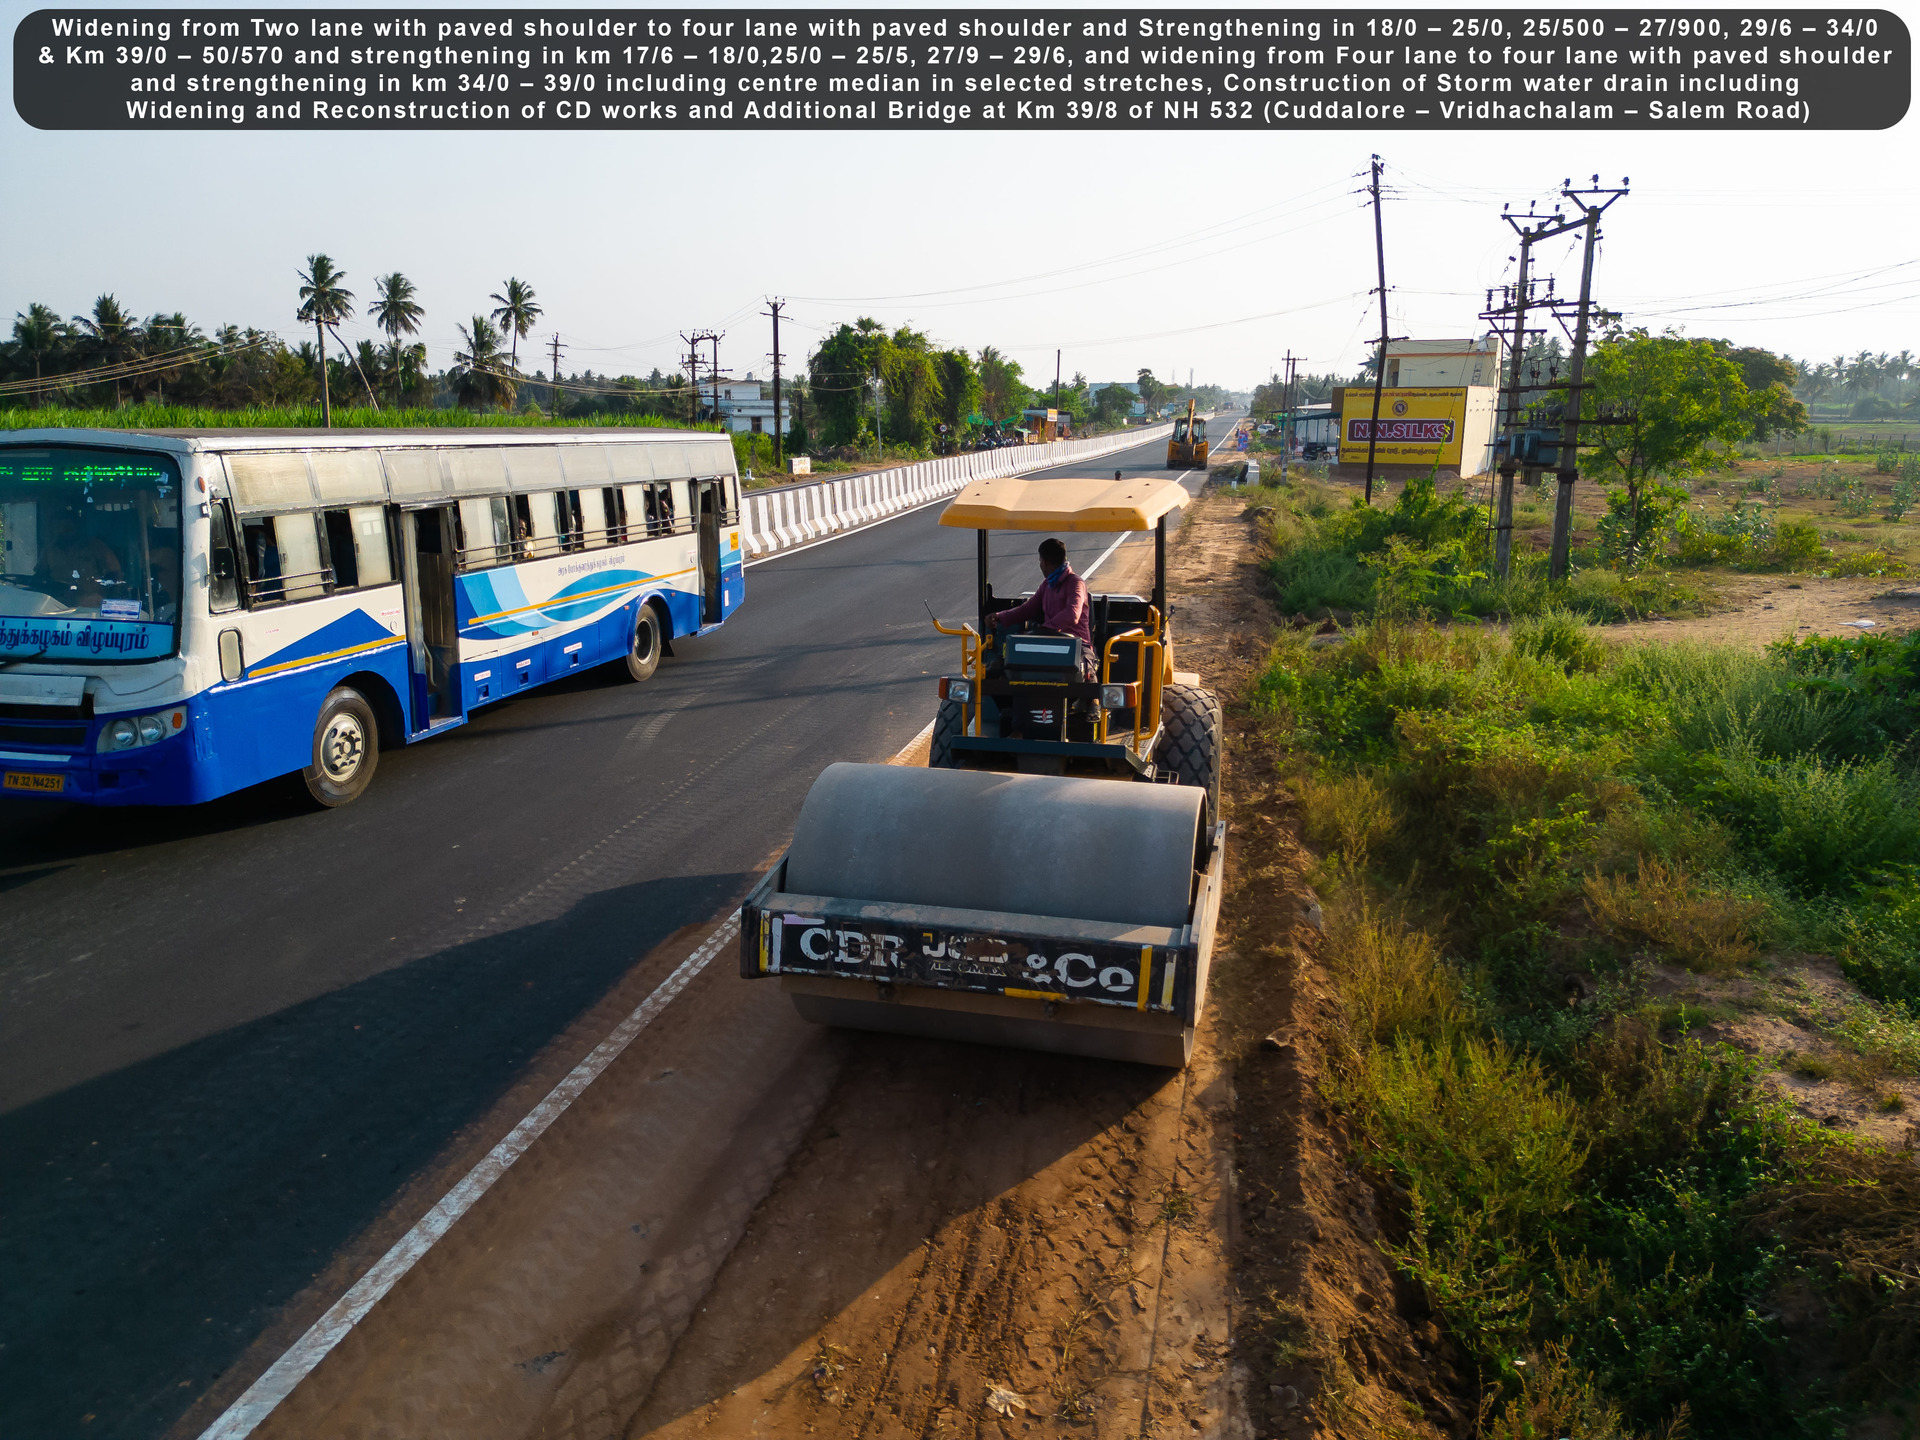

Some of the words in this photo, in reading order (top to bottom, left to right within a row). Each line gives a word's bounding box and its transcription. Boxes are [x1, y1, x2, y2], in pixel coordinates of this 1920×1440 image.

[1354, 422, 1451, 439] N.N.SILKS
[76, 625, 149, 654] விழுப்புரம்
[8, 775, 19, 787] TN
[800, 927, 905, 968] CDR
